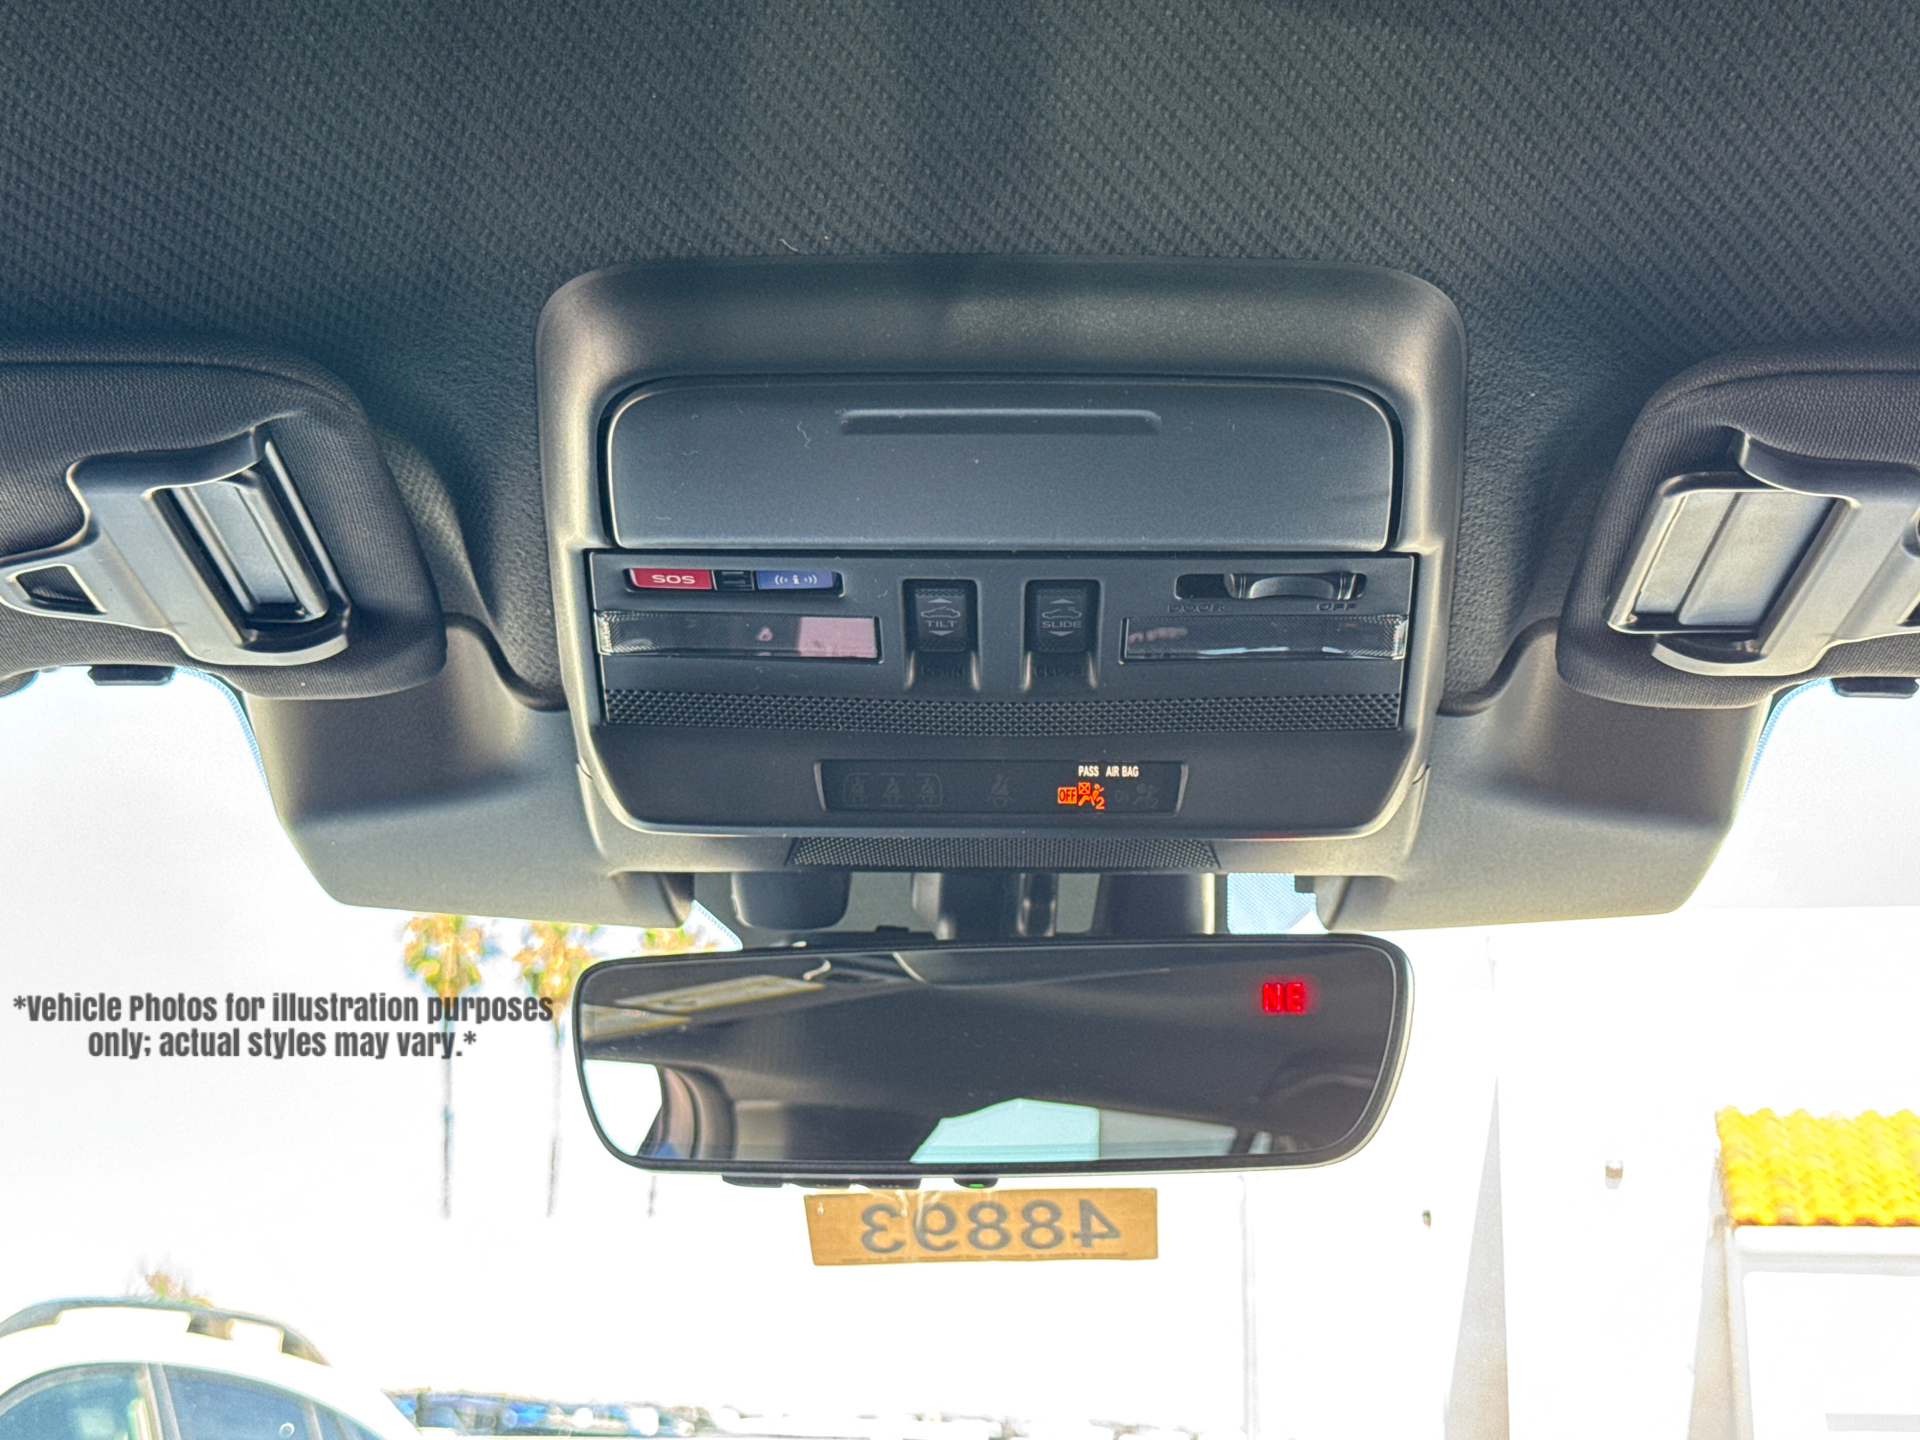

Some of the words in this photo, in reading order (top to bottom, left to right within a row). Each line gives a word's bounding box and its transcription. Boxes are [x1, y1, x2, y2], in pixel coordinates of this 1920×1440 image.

[651, 574, 696, 585] SOS
[1167, 603, 1225, 613] DOOR
[1316, 603, 1356, 611] OFF
[925, 620, 957, 628] TILT
[1042, 620, 1082, 629] SLIDE
[1078, 766, 1099, 777] PASS
[1105, 766, 1120, 777] AIR
[1121, 766, 1140, 778] BAG
[1058, 787, 1077, 804] OFF
[1262, 982, 1304, 1012] NE
